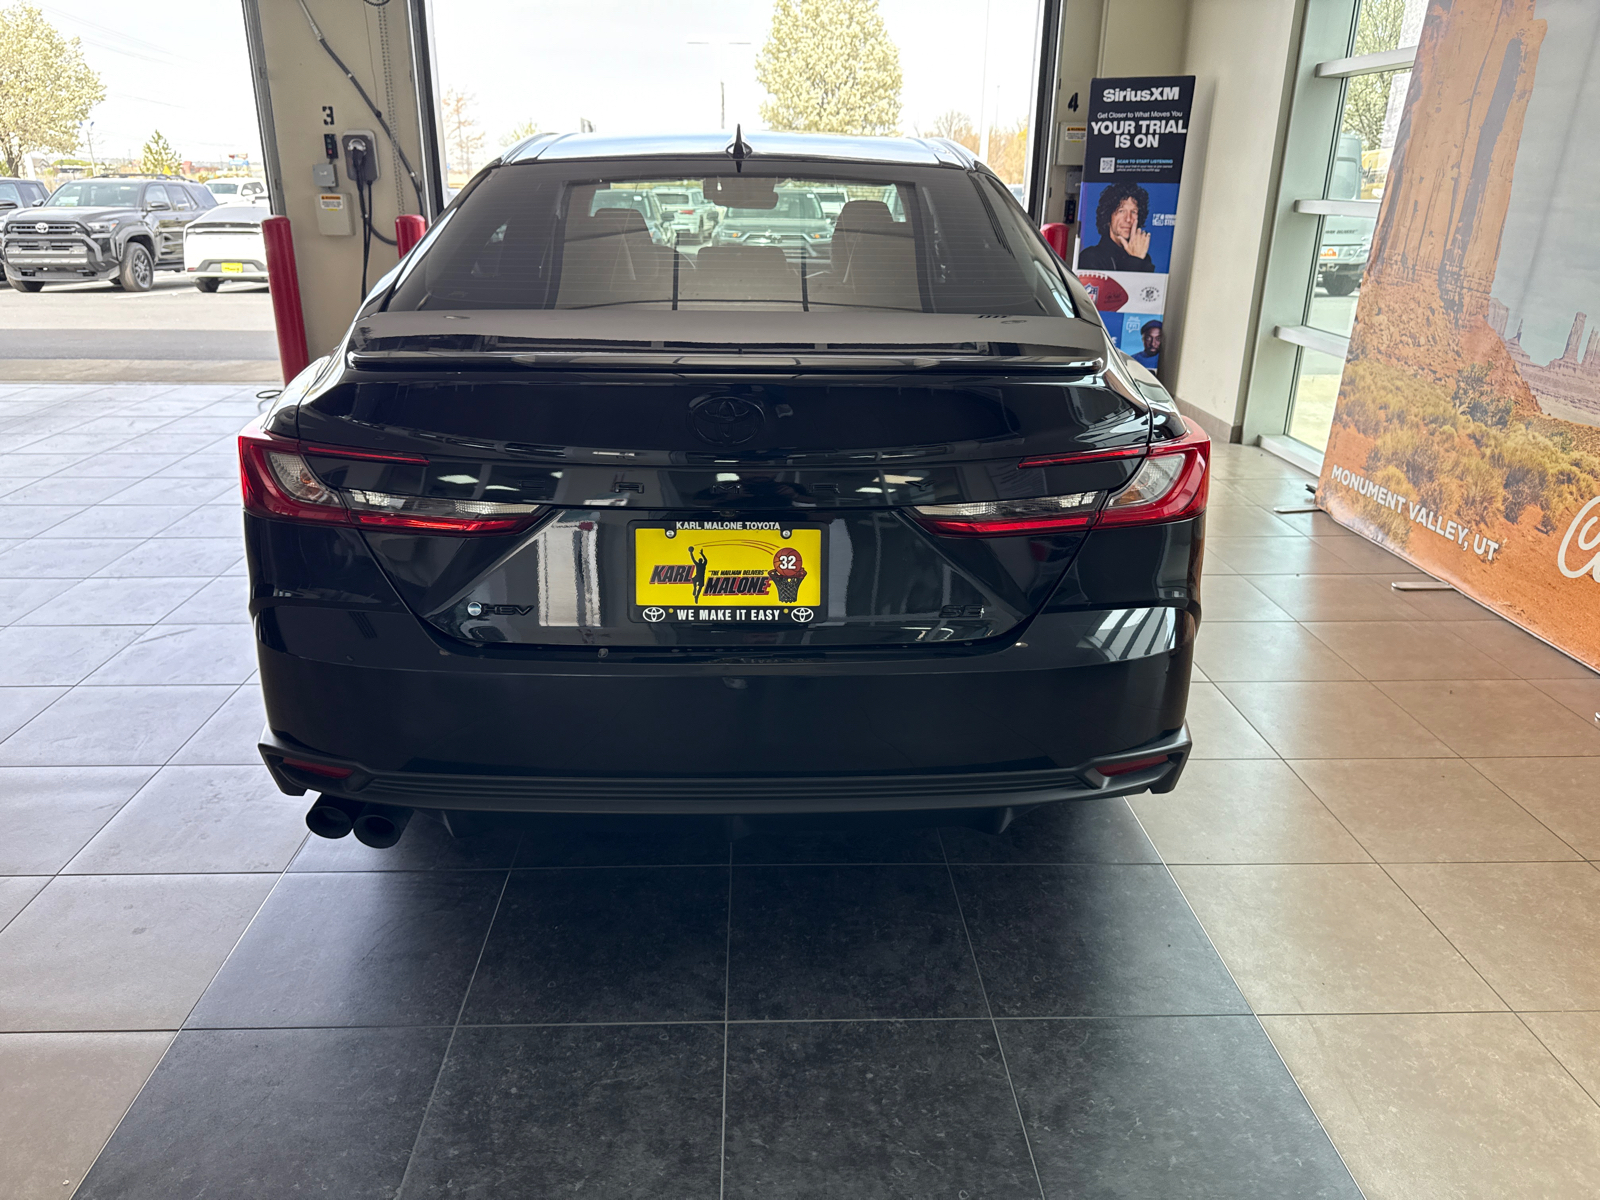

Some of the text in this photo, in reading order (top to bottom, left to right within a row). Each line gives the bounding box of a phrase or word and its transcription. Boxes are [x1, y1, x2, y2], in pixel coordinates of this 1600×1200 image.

[1103, 86, 1180, 102] SiriusXM
[1067, 92, 1079, 112] 4
[322, 106, 335, 126] 3
[1108, 111, 1127, 119] Closer
[1091, 120, 1187, 135] YOUR TRIAL
[1115, 133, 1160, 148] IS ON
[1331, 464, 1406, 513] MONUMENT
[1409, 501, 1469, 551] VALLEY,
[1473, 537, 1499, 560] UT
[676, 521, 780, 530] KARL MALONE TOYOTA
[779, 555, 796, 570] 32
[649, 564, 695, 584] KARL
[703, 576, 771, 596] MALONE
[483, 603, 534, 616] HEV
[676, 609, 780, 621] WE MAKE IT EASY
[939, 604, 984, 618] SE
